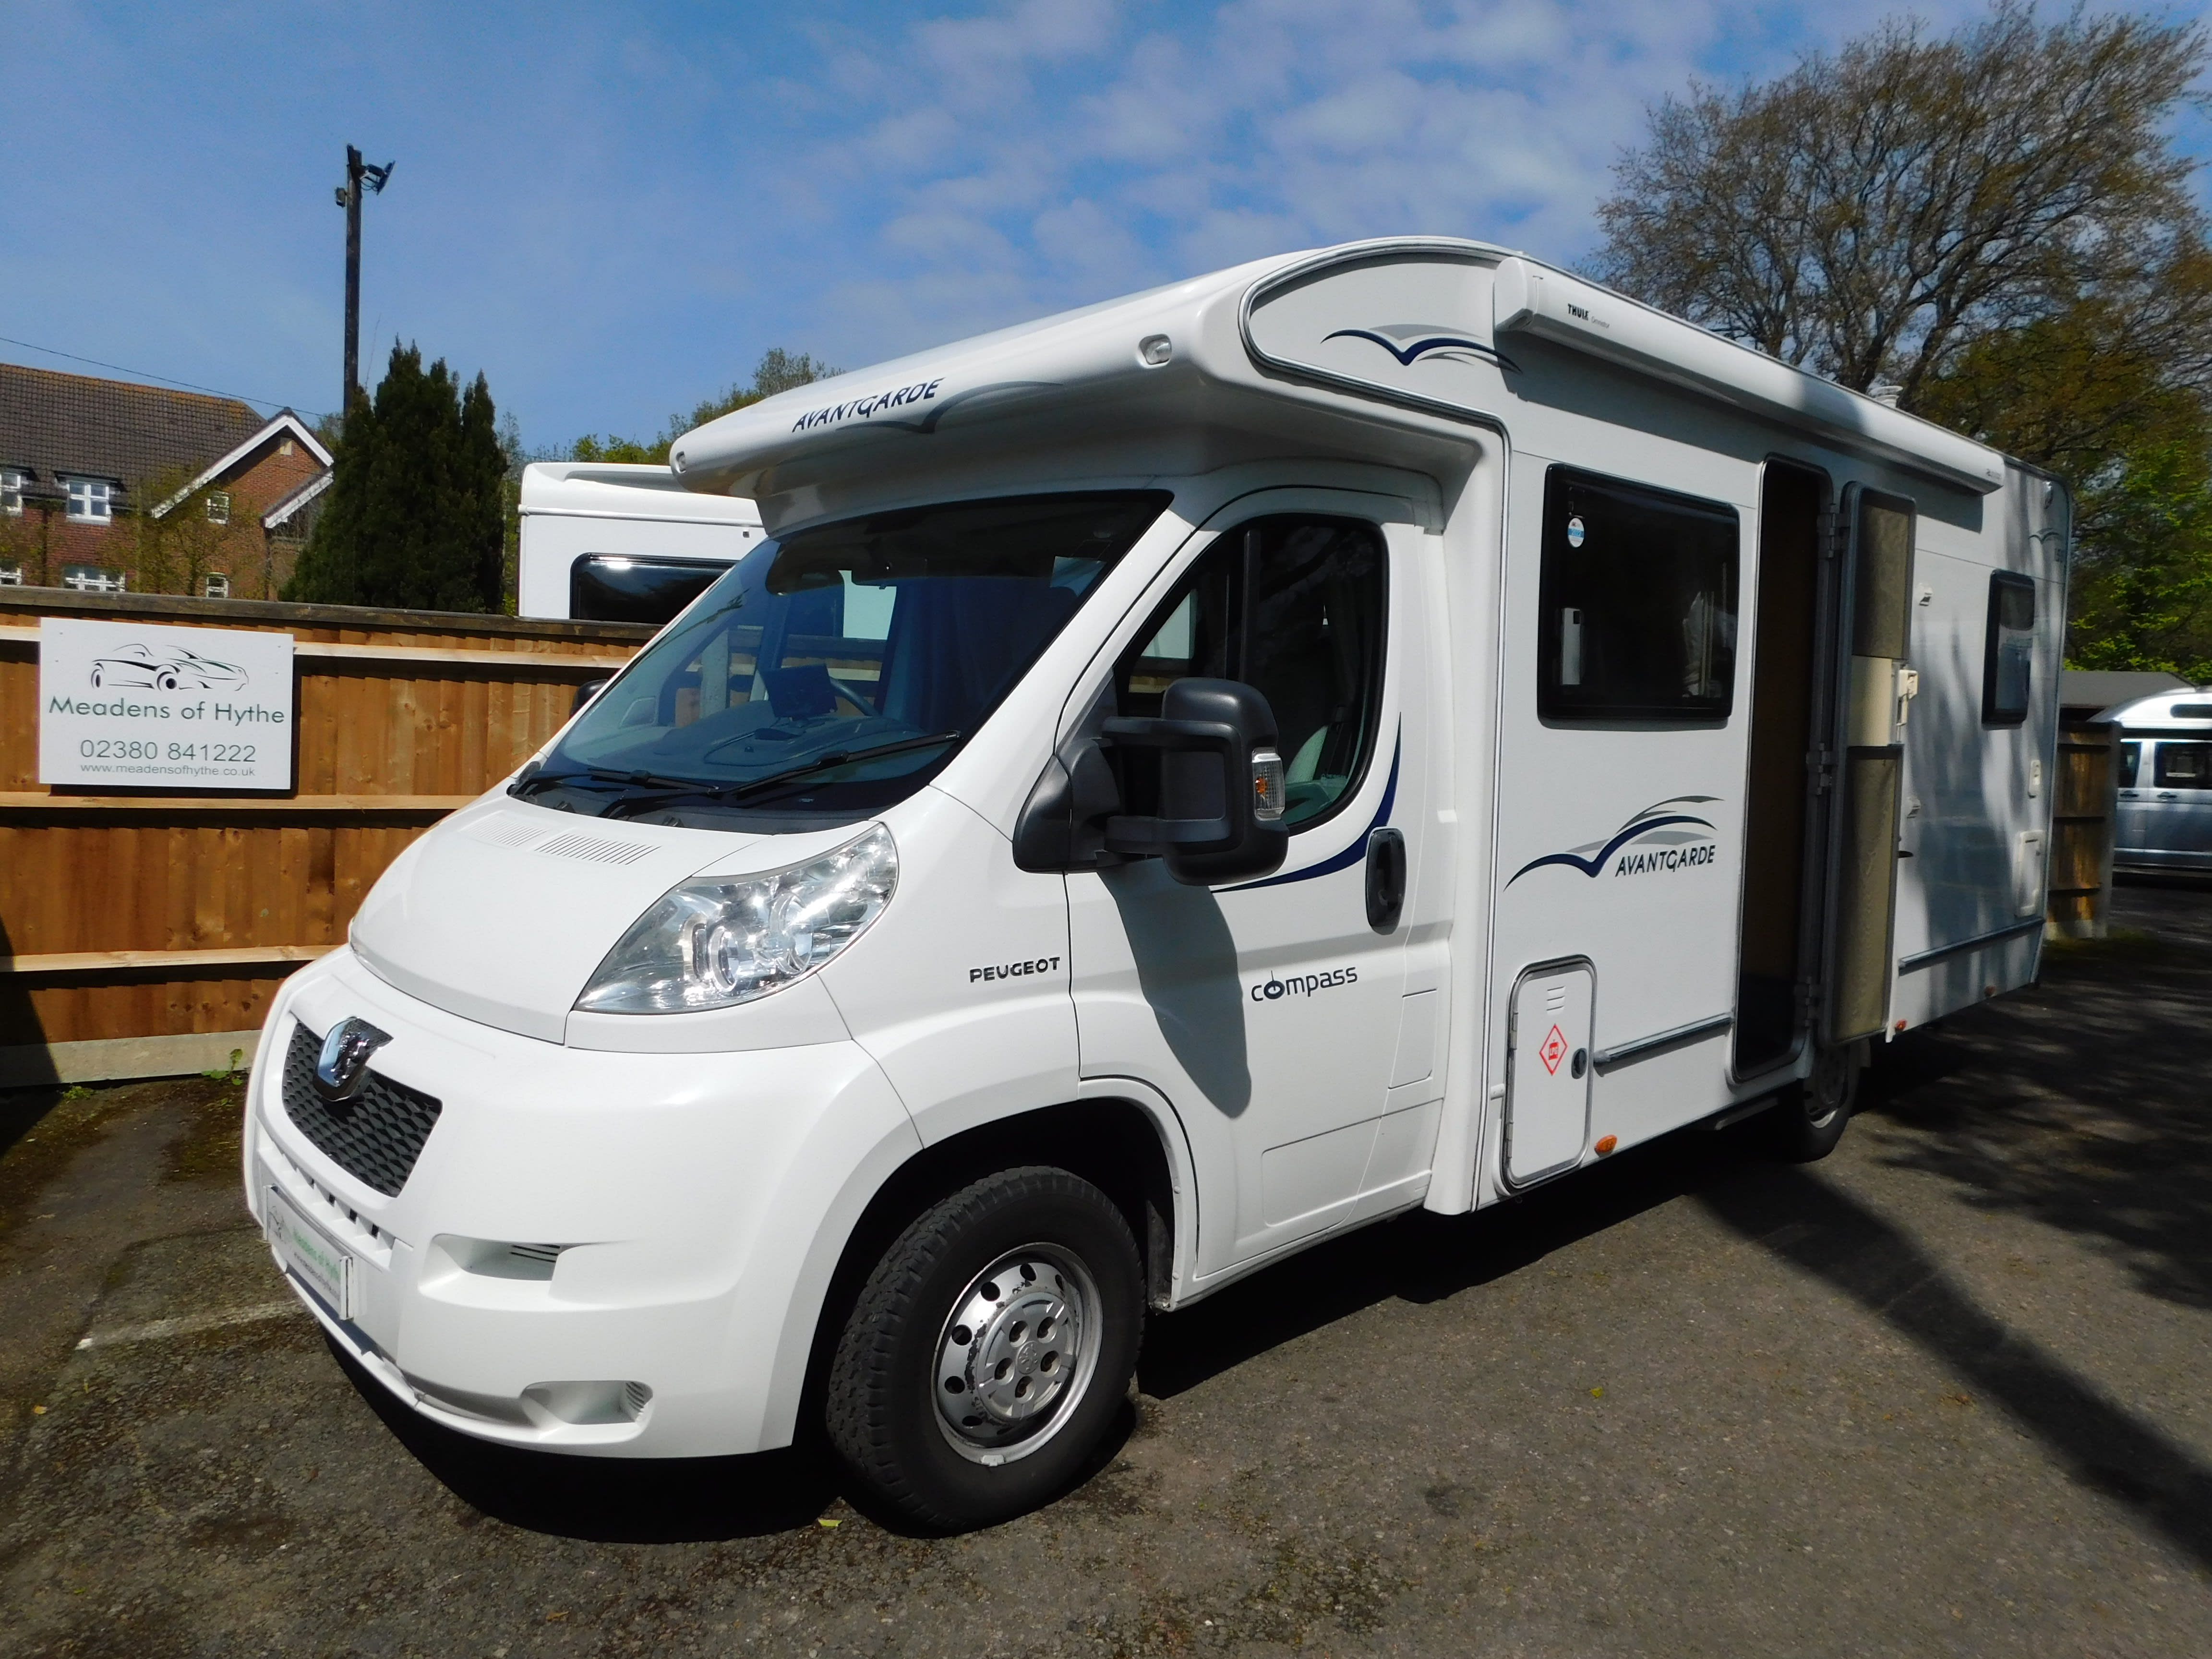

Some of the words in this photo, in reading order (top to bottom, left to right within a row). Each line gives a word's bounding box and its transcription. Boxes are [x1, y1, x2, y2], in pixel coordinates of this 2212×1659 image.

[1567, 303, 1589, 321] THULE
[792, 377, 946, 433] AVANTGARDE
[48, 696, 170, 719] Meadens
[180, 701, 205, 720] of
[215, 703, 285, 726] Hythe
[80, 739, 158, 760] 02380
[168, 742, 256, 763] 841222
[81, 764, 256, 777] www.meadensofhythe.co.uk
[1615, 845, 1716, 878] AVANTGARDE
[969, 956, 1060, 983] PEUGEOT
